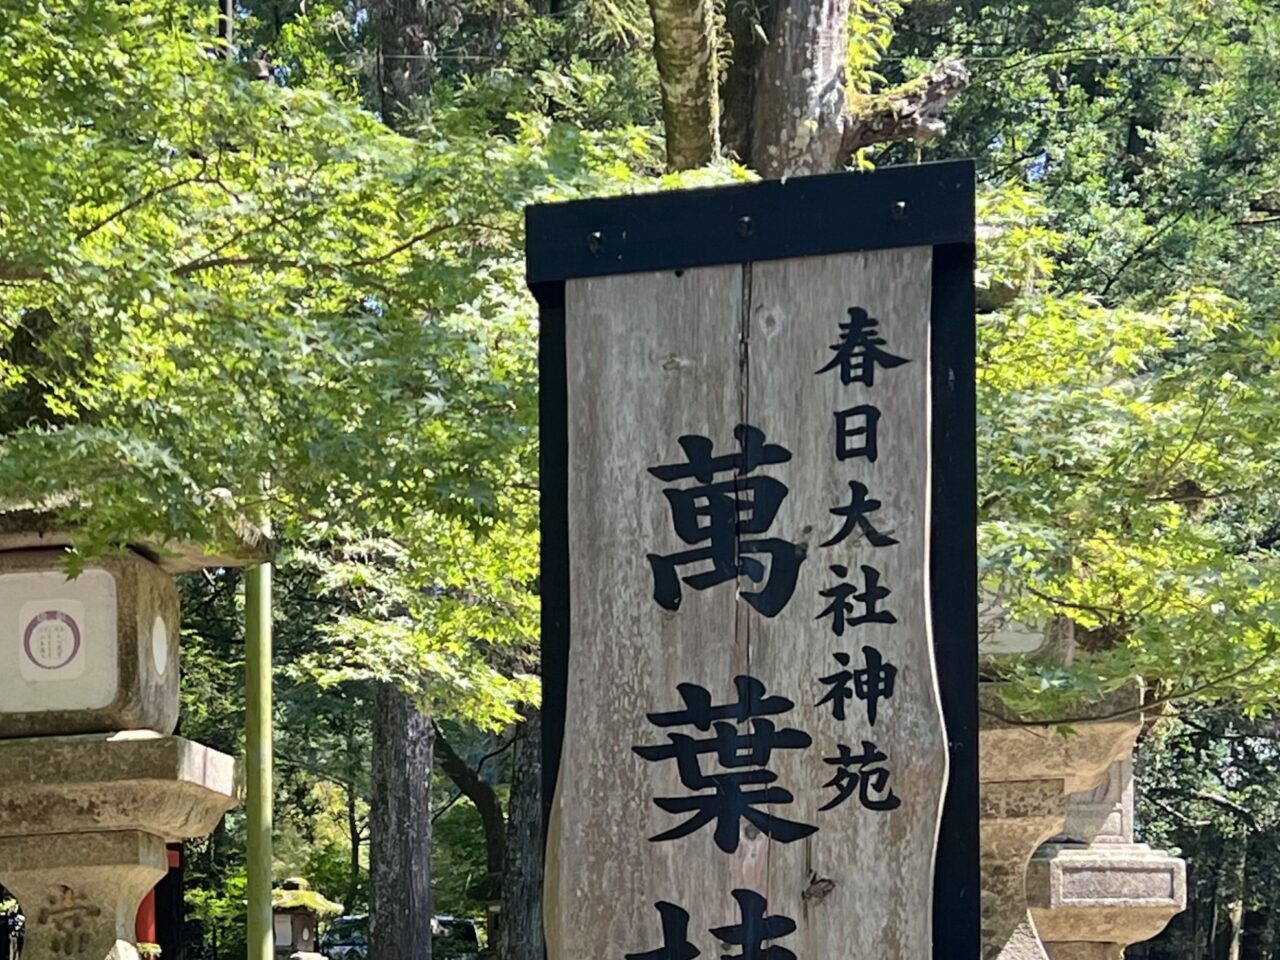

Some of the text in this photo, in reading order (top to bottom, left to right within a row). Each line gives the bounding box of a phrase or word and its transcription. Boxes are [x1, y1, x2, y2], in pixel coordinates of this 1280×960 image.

[814, 306, 913, 812] 春日大社神苑
